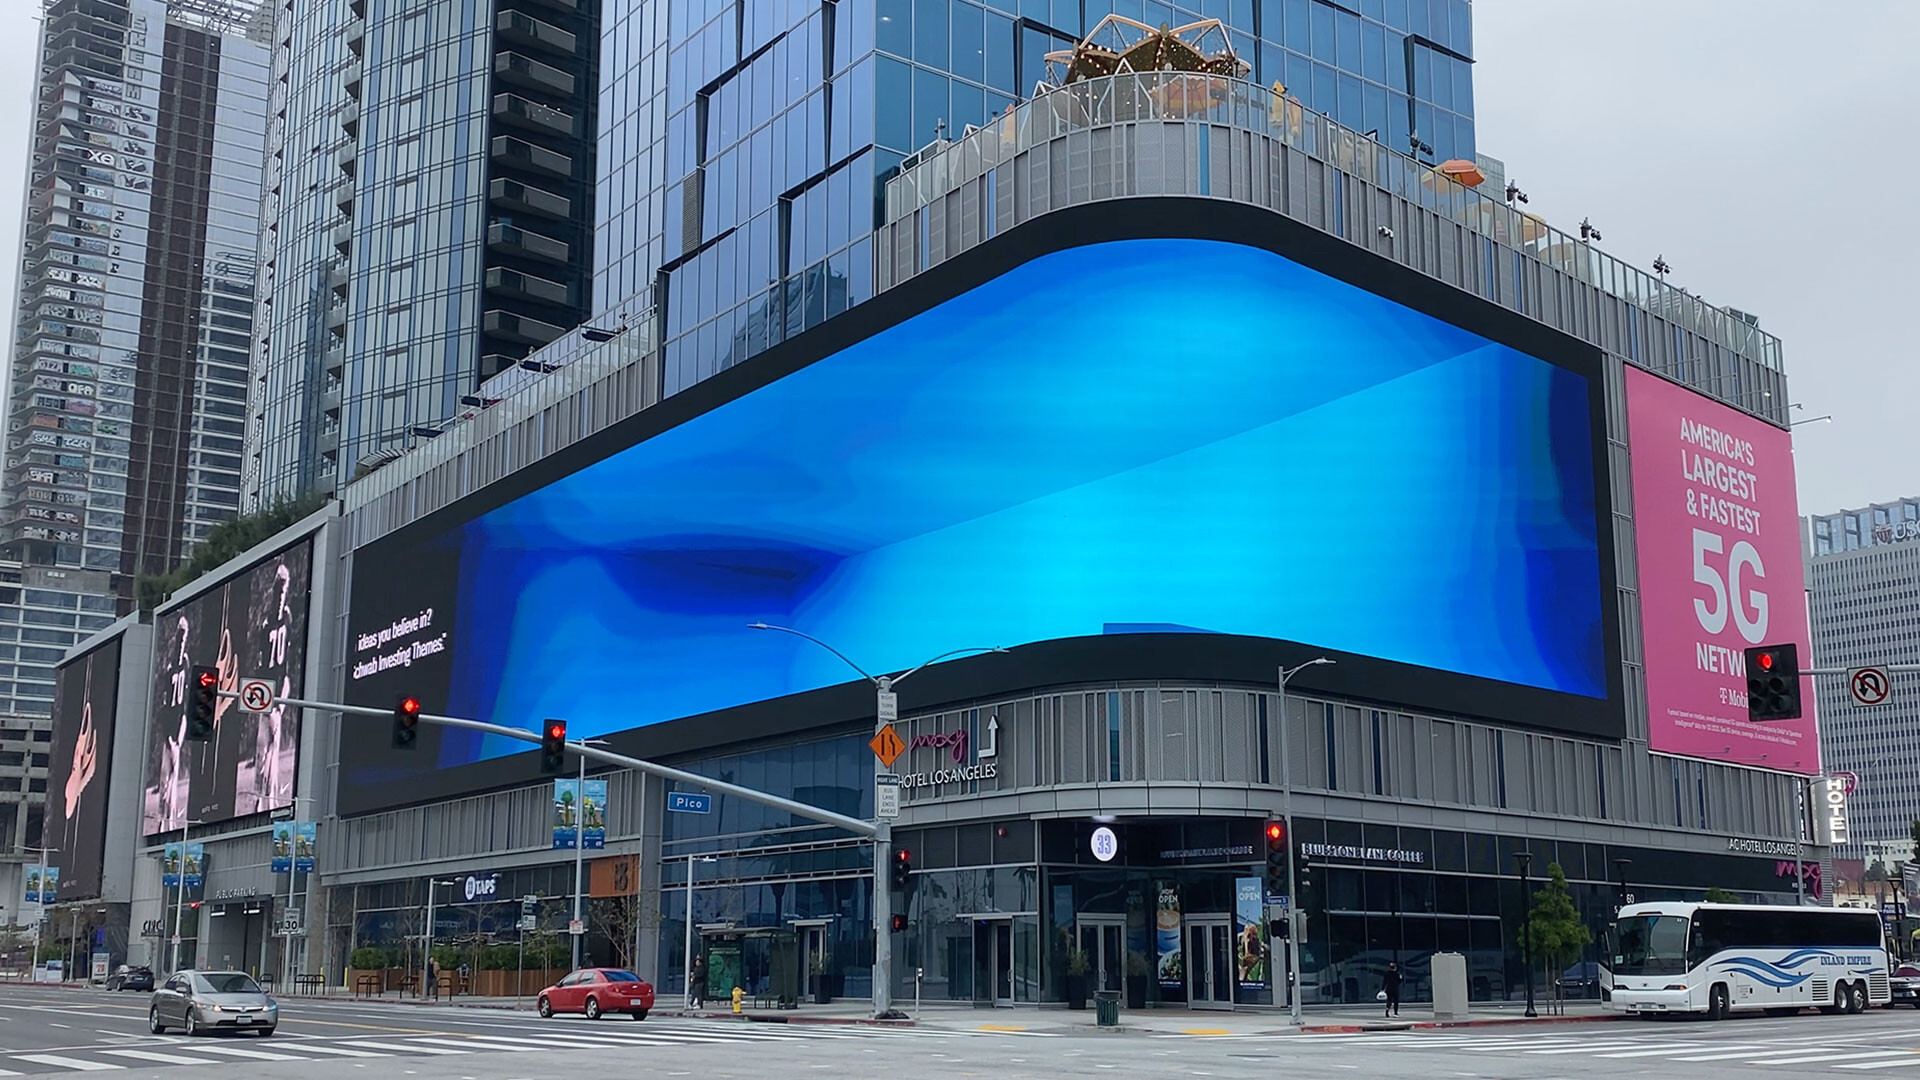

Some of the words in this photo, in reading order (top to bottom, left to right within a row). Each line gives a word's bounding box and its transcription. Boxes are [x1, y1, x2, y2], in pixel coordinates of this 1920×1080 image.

[1680, 417, 1755, 467] AMERICA'S
[1682, 449, 1757, 503] LARGEST
[1686, 488, 1698, 517] &
[1700, 492, 1760, 537] FASTEST
[1692, 527, 1769, 645] 5G
[268, 624, 287, 669] 70
[358, 633, 378, 651] ideas
[376, 627, 392, 649] you
[392, 617, 419, 639] believe
[419, 608, 433, 629] in?
[352, 656, 378, 680] chwab
[378, 646, 412, 667] Investing
[1696, 642, 1747, 678] NETW
[171, 669, 186, 708] 70
[1728, 690, 1749, 709] Mobi
[899, 772, 928, 790] HOTEL
[676, 797, 702, 809] Pico
[1825, 777, 1848, 845] HOTEL
[1728, 838, 1740, 851] AC
[1740, 839, 1763, 853] HOTEL
[1775, 843, 1804, 856] ANGELS
[475, 879, 496, 895] TAPS
[1158, 895, 1178, 903] OPEN
[1238, 892, 1261, 901] OPEN
[284, 920, 298, 930] 30
[1820, 956, 1846, 966] INLAND
[1846, 956, 1872, 966] EMPIRE
